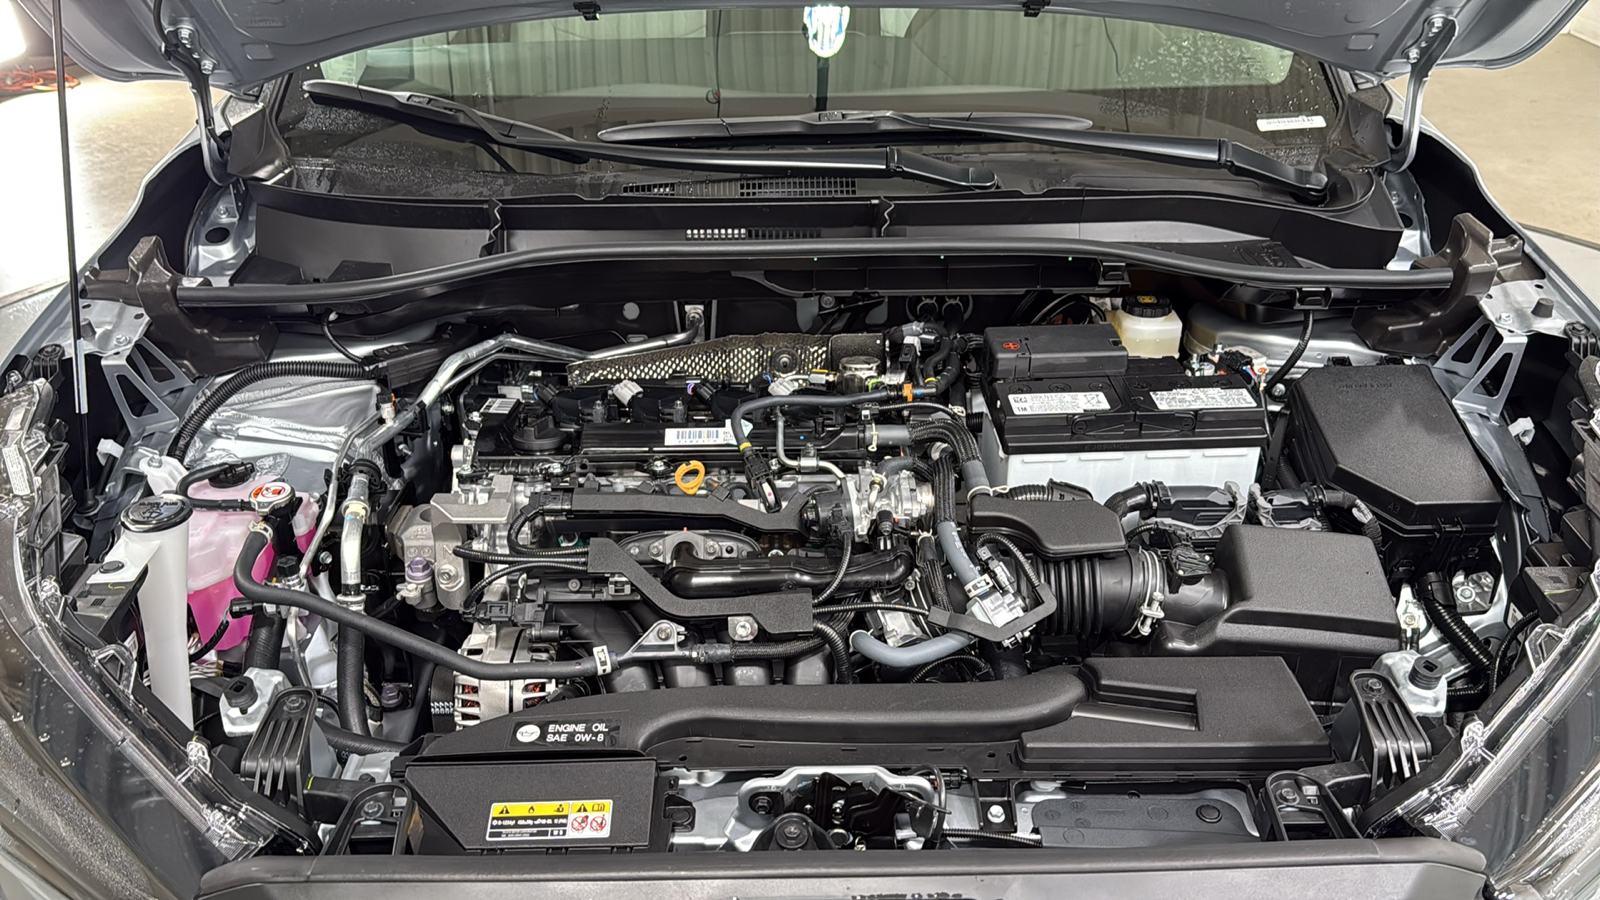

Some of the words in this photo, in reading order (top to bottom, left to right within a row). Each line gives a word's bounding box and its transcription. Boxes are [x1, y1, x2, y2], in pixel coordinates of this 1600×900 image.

[548, 724, 586, 733] ENGINE
[592, 723, 609, 732] OIL
[546, 734, 568, 742] SAE
[574, 733, 604, 742] 0W-8
